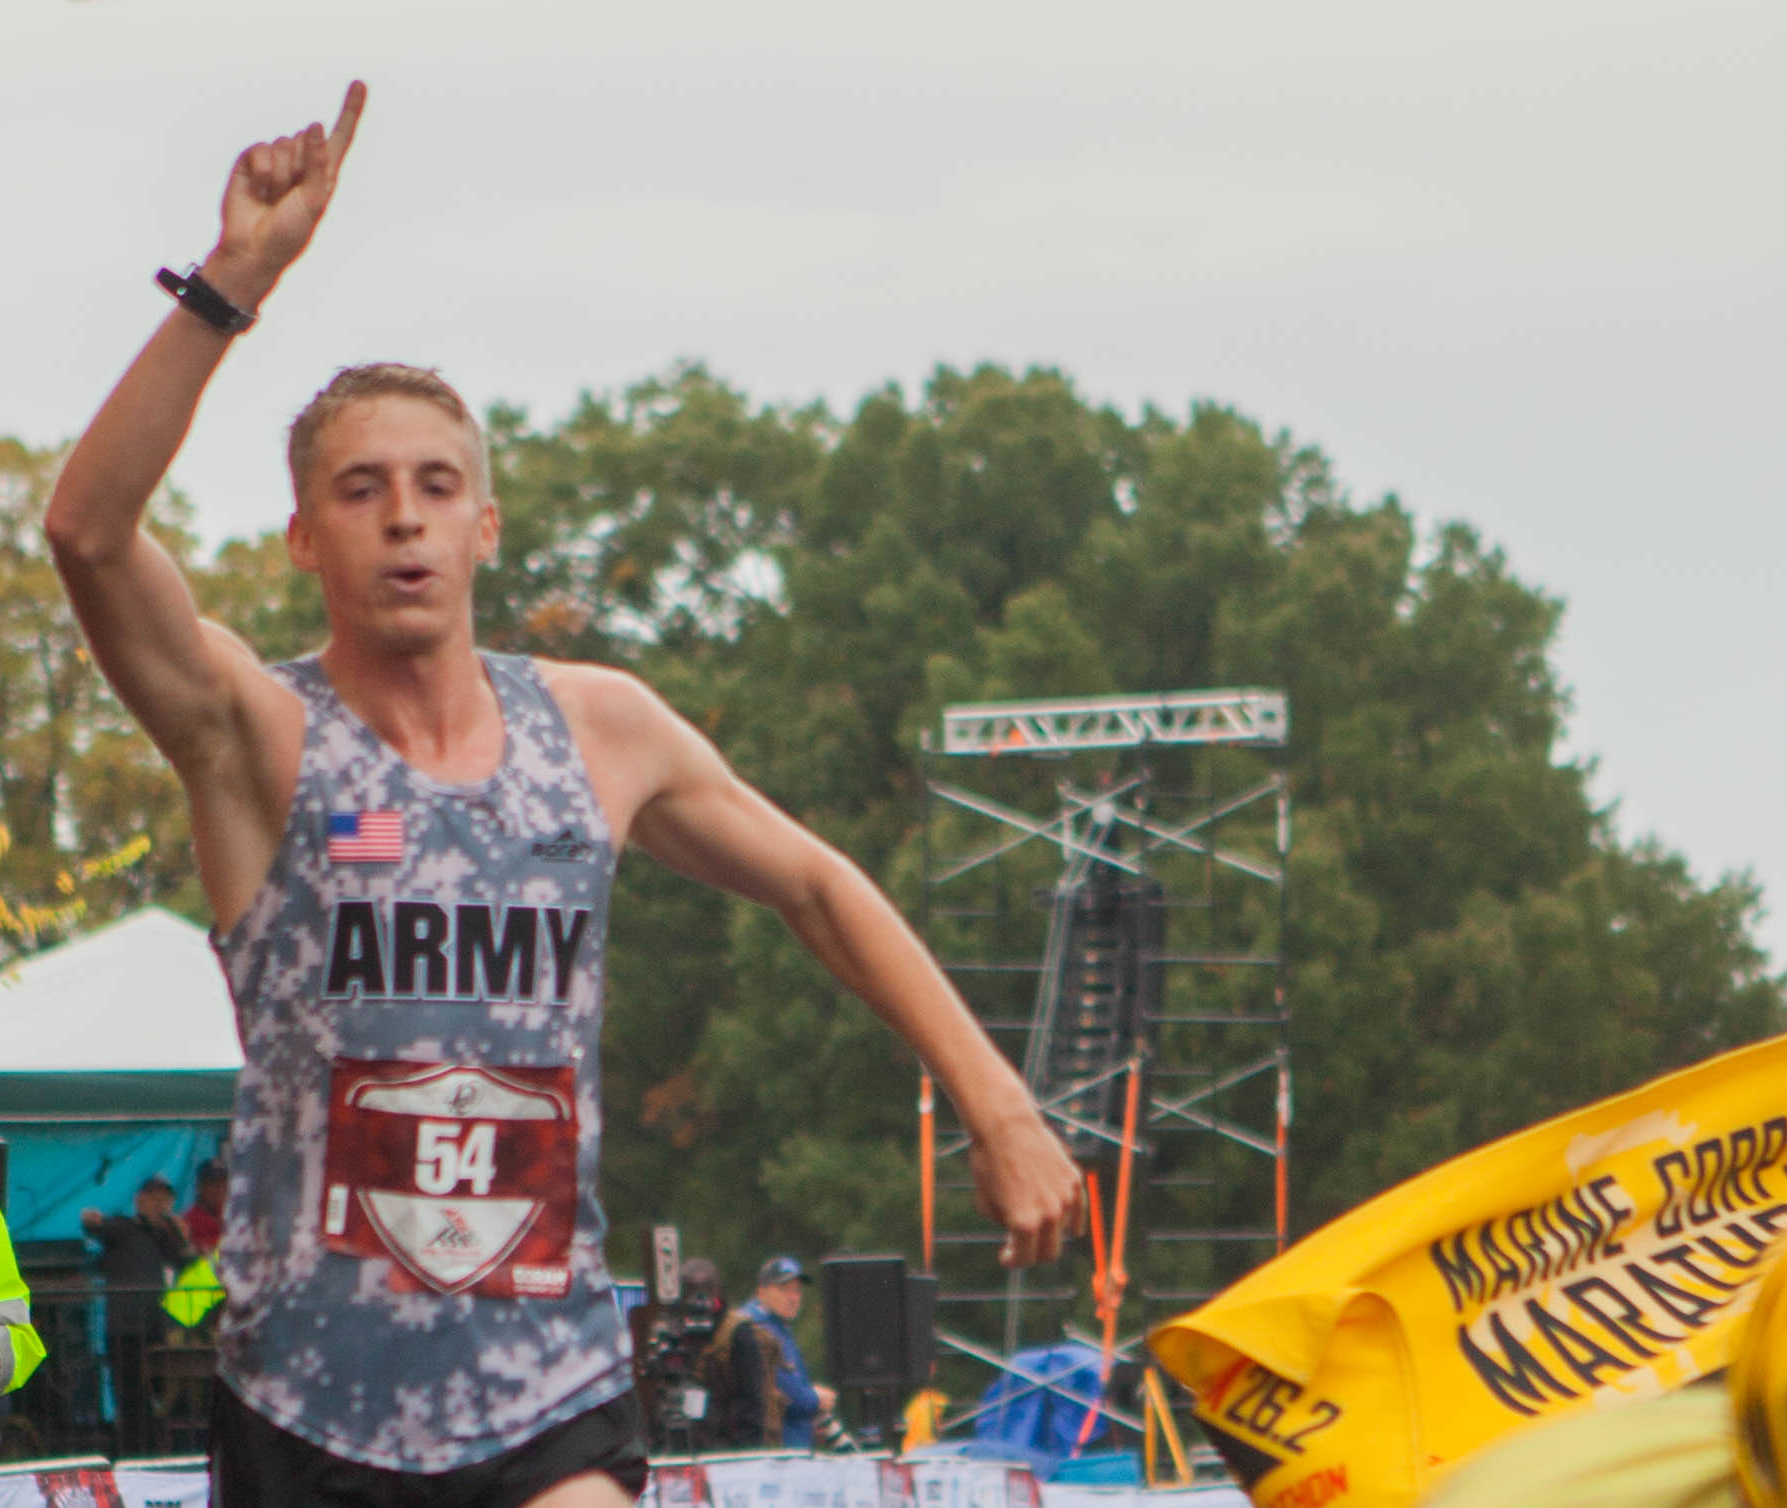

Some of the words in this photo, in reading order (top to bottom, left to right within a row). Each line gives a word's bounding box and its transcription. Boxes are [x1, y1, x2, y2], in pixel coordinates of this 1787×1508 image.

[324, 900, 592, 1003] ARMY
[415, 1121, 497, 1195] 54
[1429, 1175, 1637, 1314] MARINE
[1225, 1365, 1343, 1455] 26.2
